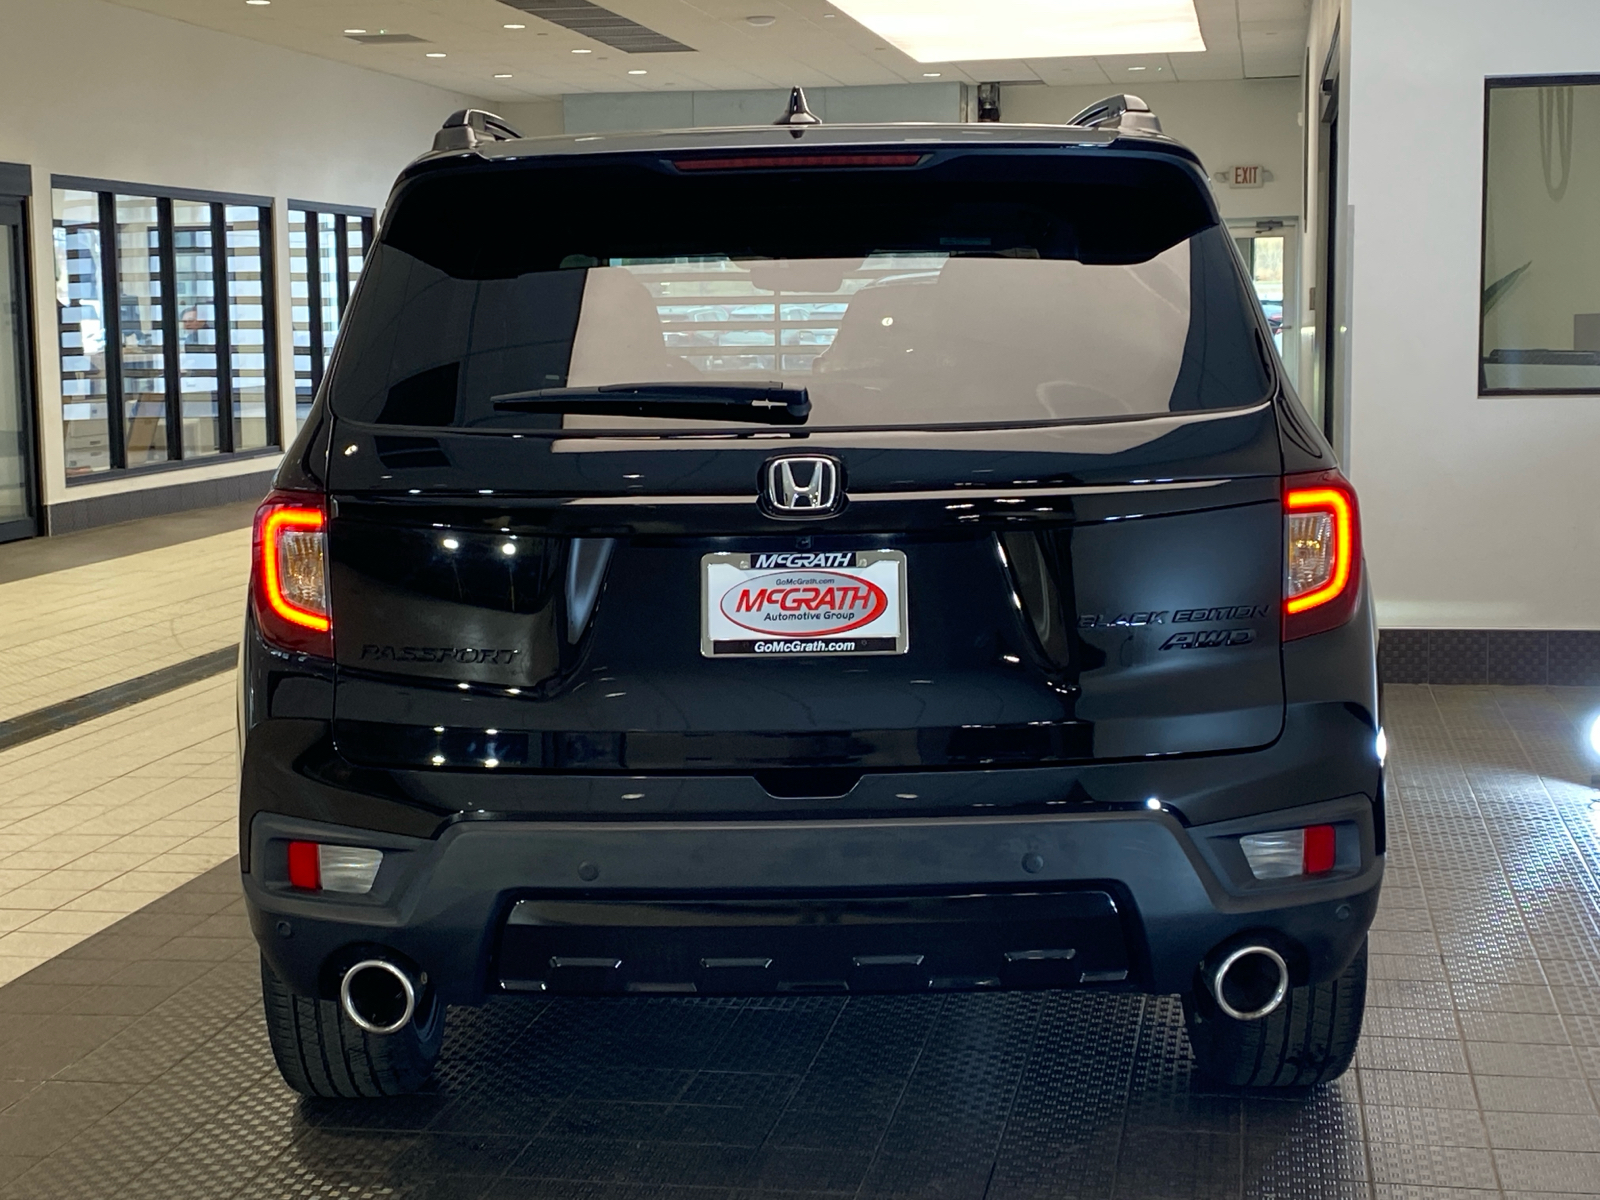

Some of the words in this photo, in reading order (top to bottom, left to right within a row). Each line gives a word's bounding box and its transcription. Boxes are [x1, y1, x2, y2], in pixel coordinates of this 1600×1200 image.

[1235, 166, 1258, 184] EXIT
[776, 578, 835, 586] GoMcGrath.com
[764, 612, 821, 622] Automotive
[824, 611, 855, 621] Group
[1077, 611, 1169, 628] BLACK
[1171, 605, 1270, 624] EDITION
[754, 640, 856, 652] GoMcGrath.com
[1158, 628, 1257, 651] AWD
[360, 644, 520, 665] PASSPORT
